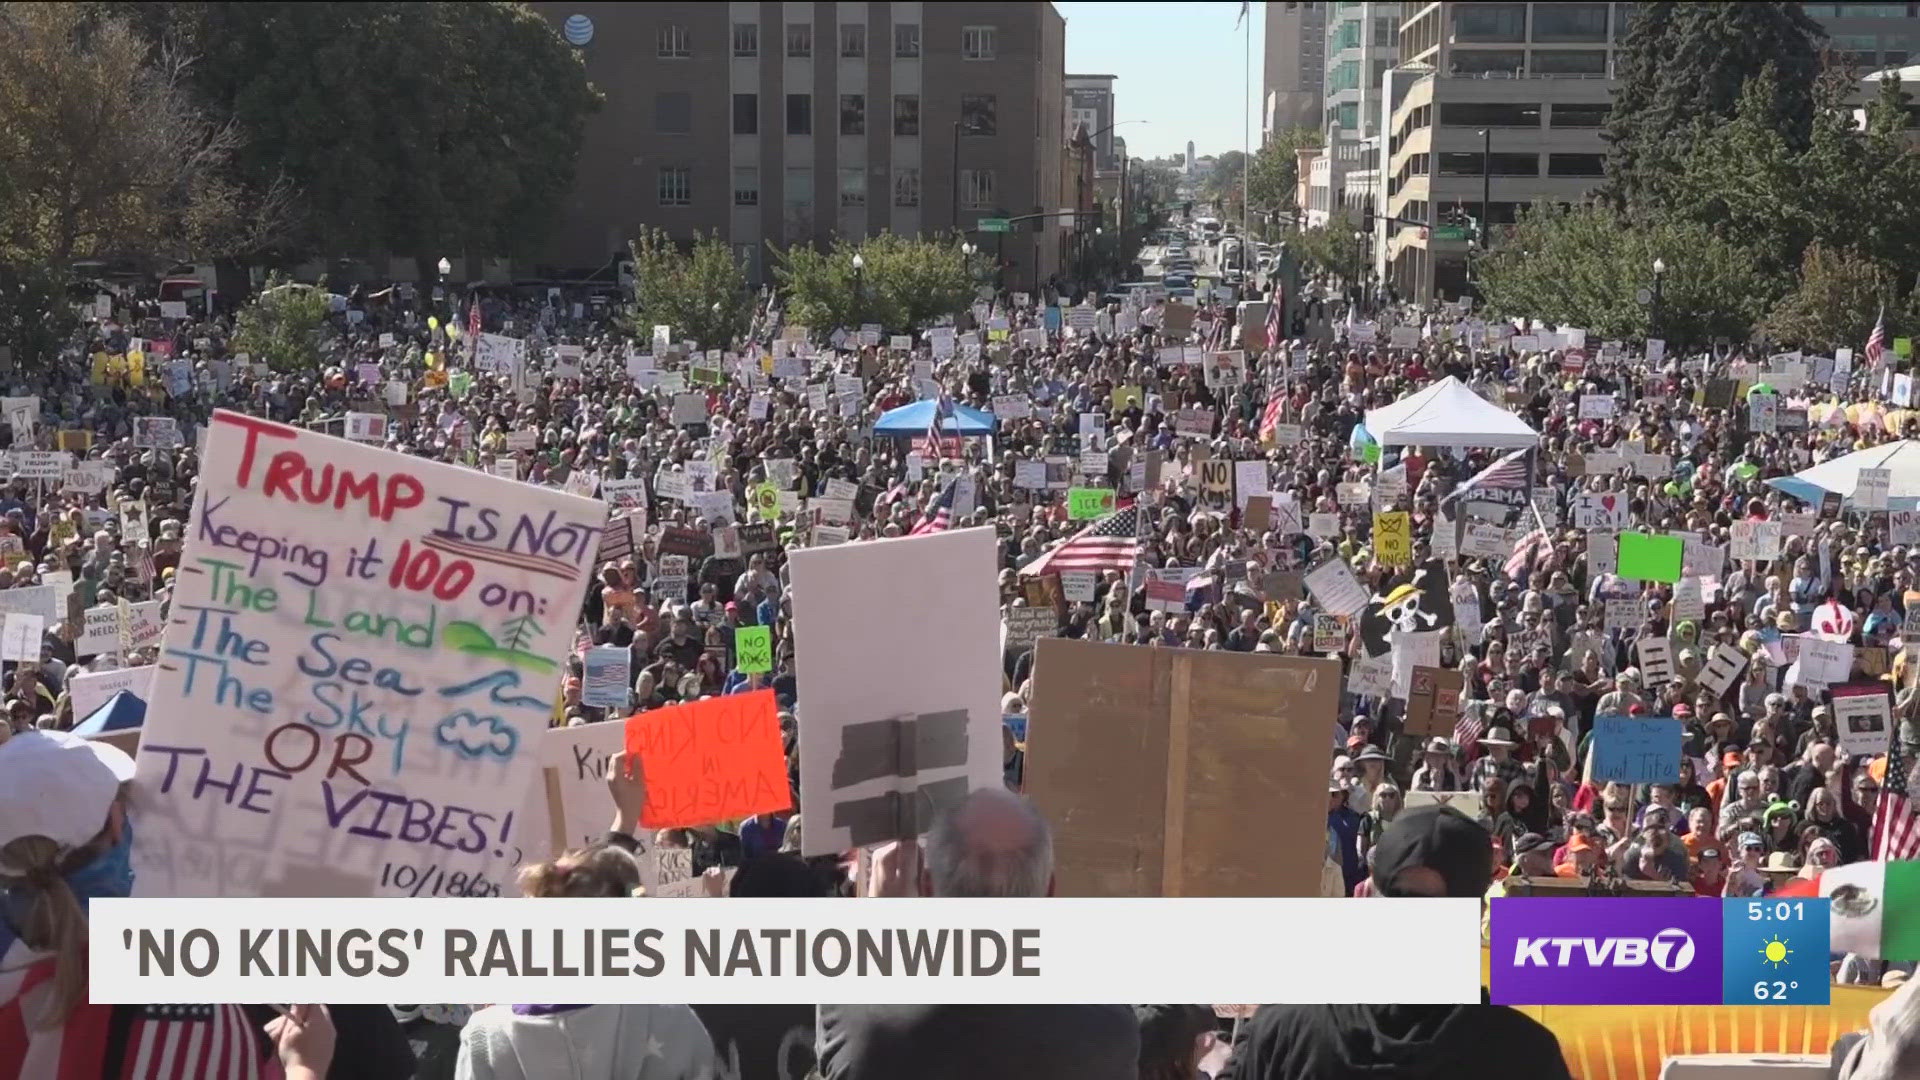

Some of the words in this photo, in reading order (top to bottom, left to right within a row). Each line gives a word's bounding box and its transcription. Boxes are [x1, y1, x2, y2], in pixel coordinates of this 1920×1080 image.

[212, 410, 424, 522] TRUMP
[436, 497, 500, 542] IS
[508, 510, 603, 562] NOT
[1202, 463, 1227, 484] NO
[1079, 499, 1099, 510] ICE
[1581, 497, 1592, 508] I
[1893, 512, 1911, 527] NO
[198, 490, 328, 586] Keeping
[346, 537, 382, 578] it
[388, 540, 476, 600] 100
[479, 582, 548, 616] on:
[1376, 553, 1409, 564] KINGS
[1384, 540, 1399, 550] NO
[305, 590, 436, 650] Land
[744, 636, 766, 648] NO
[297, 633, 424, 696] Sea
[307, 682, 410, 777] Sky
[264, 722, 374, 786] OR
[142, 744, 293, 815] THE
[321, 780, 514, 859] VIBES!
